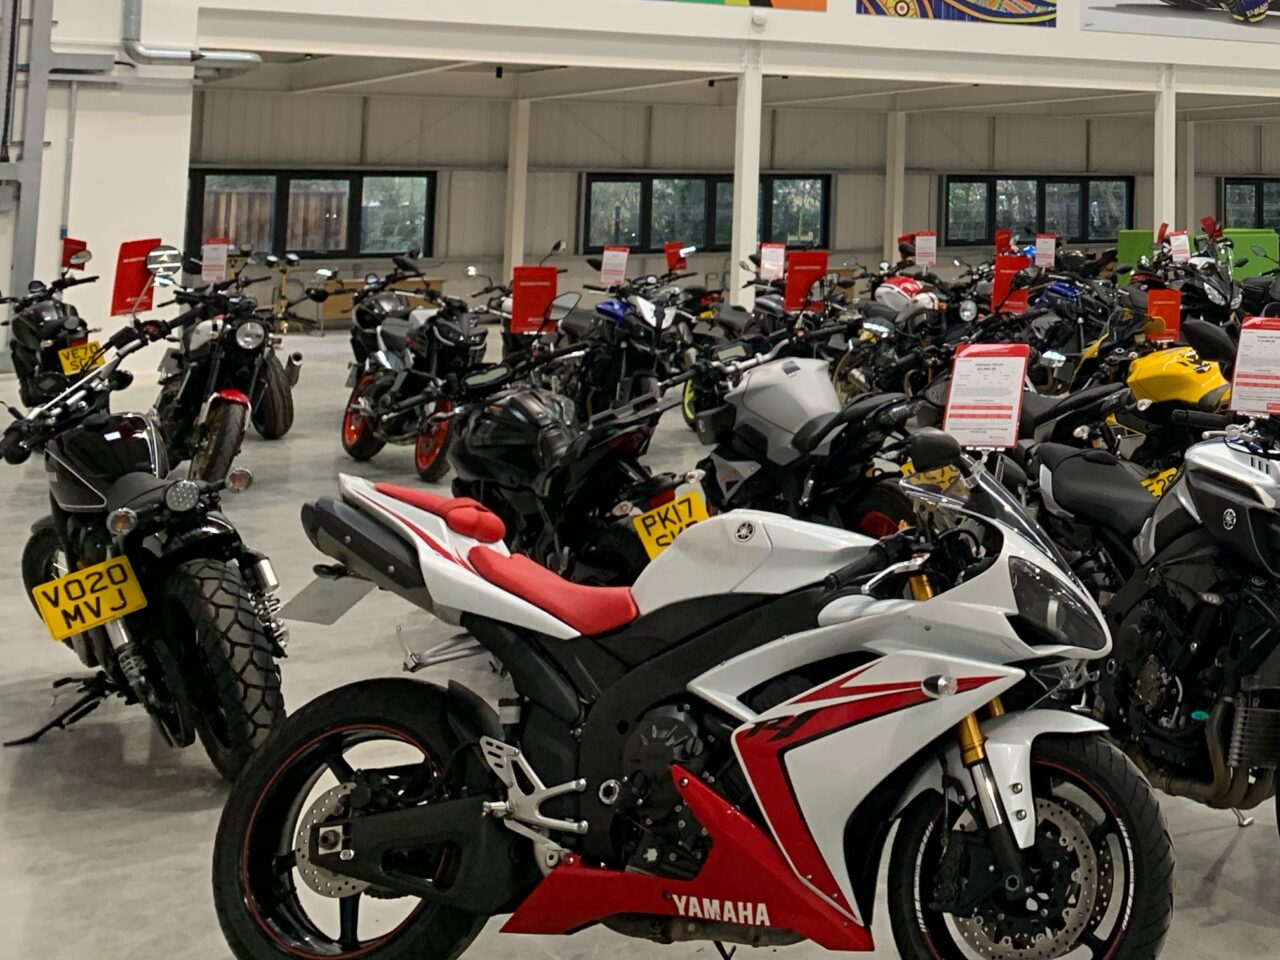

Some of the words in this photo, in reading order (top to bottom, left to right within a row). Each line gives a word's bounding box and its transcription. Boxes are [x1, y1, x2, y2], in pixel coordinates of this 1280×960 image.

[641, 497, 693, 536] PK17
[42, 563, 128, 608] VO20
[60, 588, 128, 629] MVJ
[671, 893, 771, 927] YAMAHA
